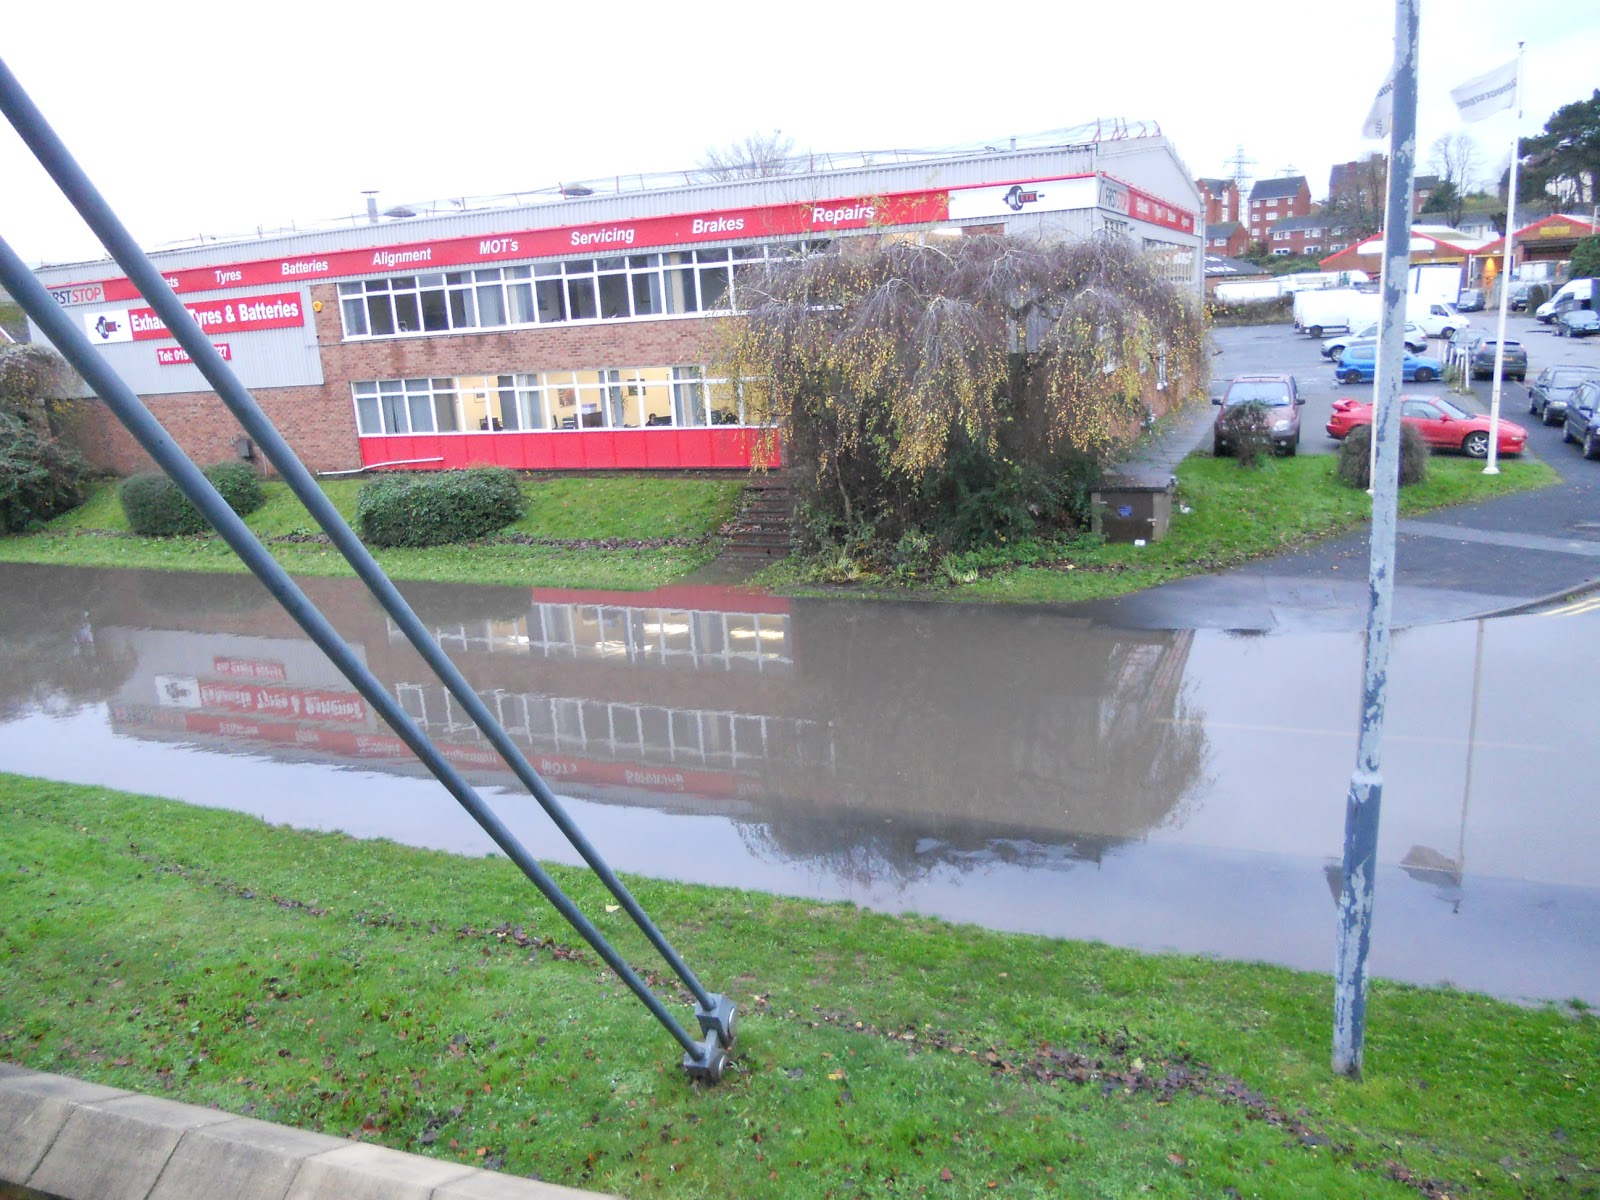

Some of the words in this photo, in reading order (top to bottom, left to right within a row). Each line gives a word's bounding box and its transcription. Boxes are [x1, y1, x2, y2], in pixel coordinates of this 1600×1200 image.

[812, 204, 876, 225] Repairs
[692, 217, 744, 234] Brakes
[571, 228, 635, 246] Servicing
[480, 239, 519, 254] MOT's
[373, 247, 432, 267] Alignment
[281, 259, 329, 275] Batteries
[215, 270, 242, 285] Tyres
[131, 312, 166, 332] Exha
[225, 305, 236, 323] &
[238, 300, 299, 322] Batteries
[158, 350, 173, 362] Tel:
